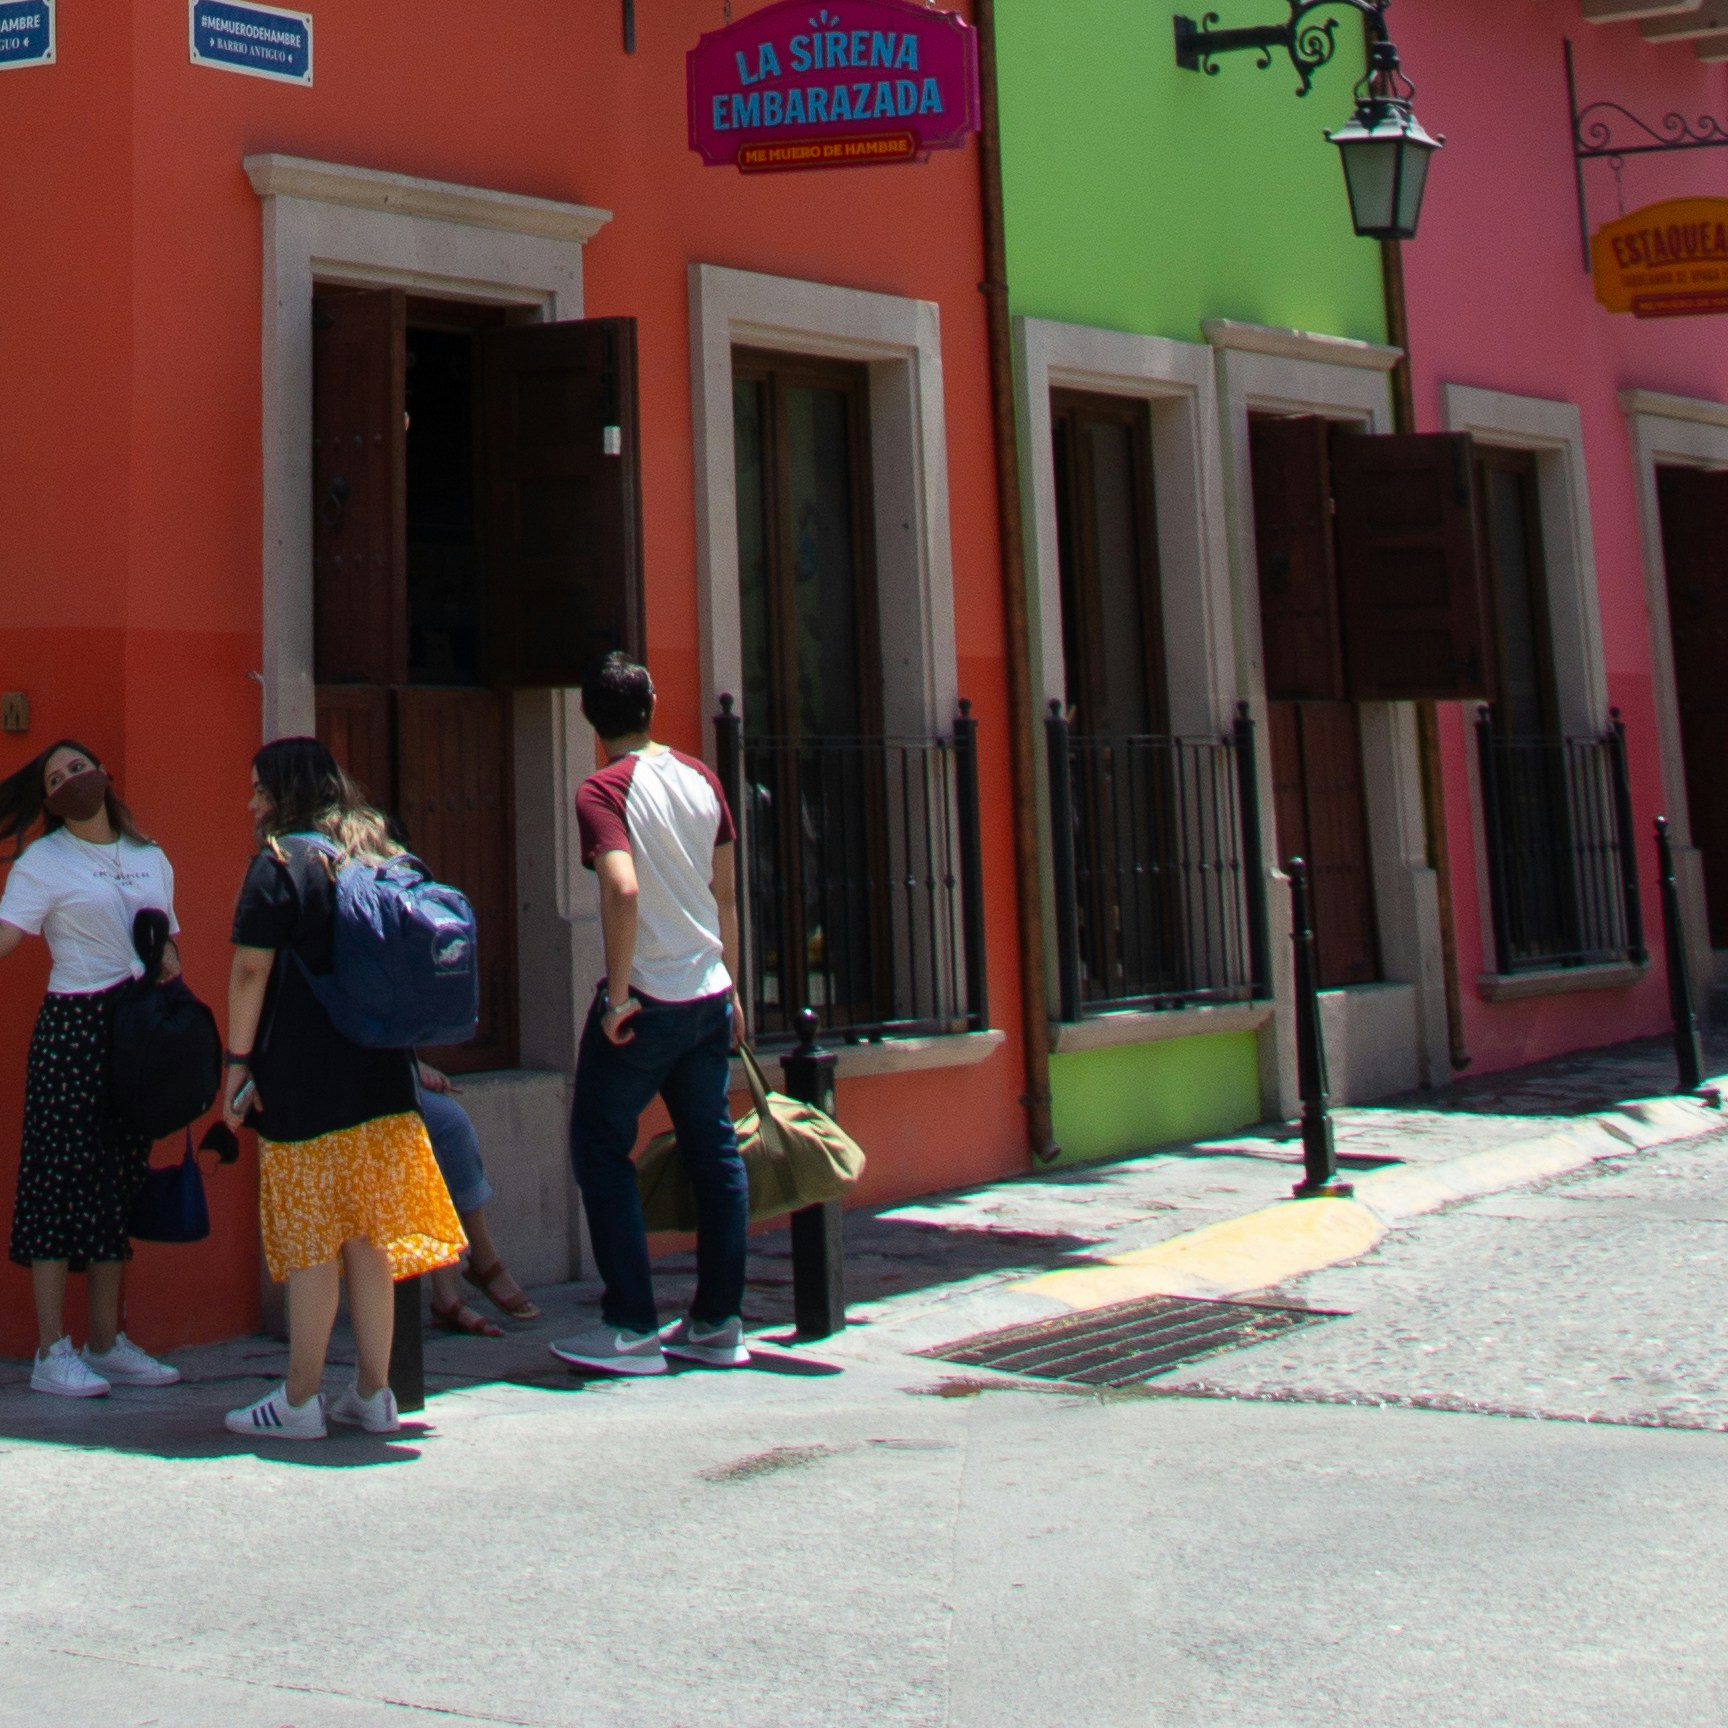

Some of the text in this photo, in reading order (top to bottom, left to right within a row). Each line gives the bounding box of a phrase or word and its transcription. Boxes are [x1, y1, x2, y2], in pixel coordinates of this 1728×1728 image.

[201, 14, 302, 49] #MEMUERODEHAMBRE
[216, 37, 287, 64] BARRIO ANTIGUO
[735, 30, 919, 86] LA SIRENA
[712, 77, 944, 131] EMBARAZADA
[745, 139, 909, 163] ME MUERO DE HAMBRE
[1612, 222, 1727, 269] ESTAQUEA
